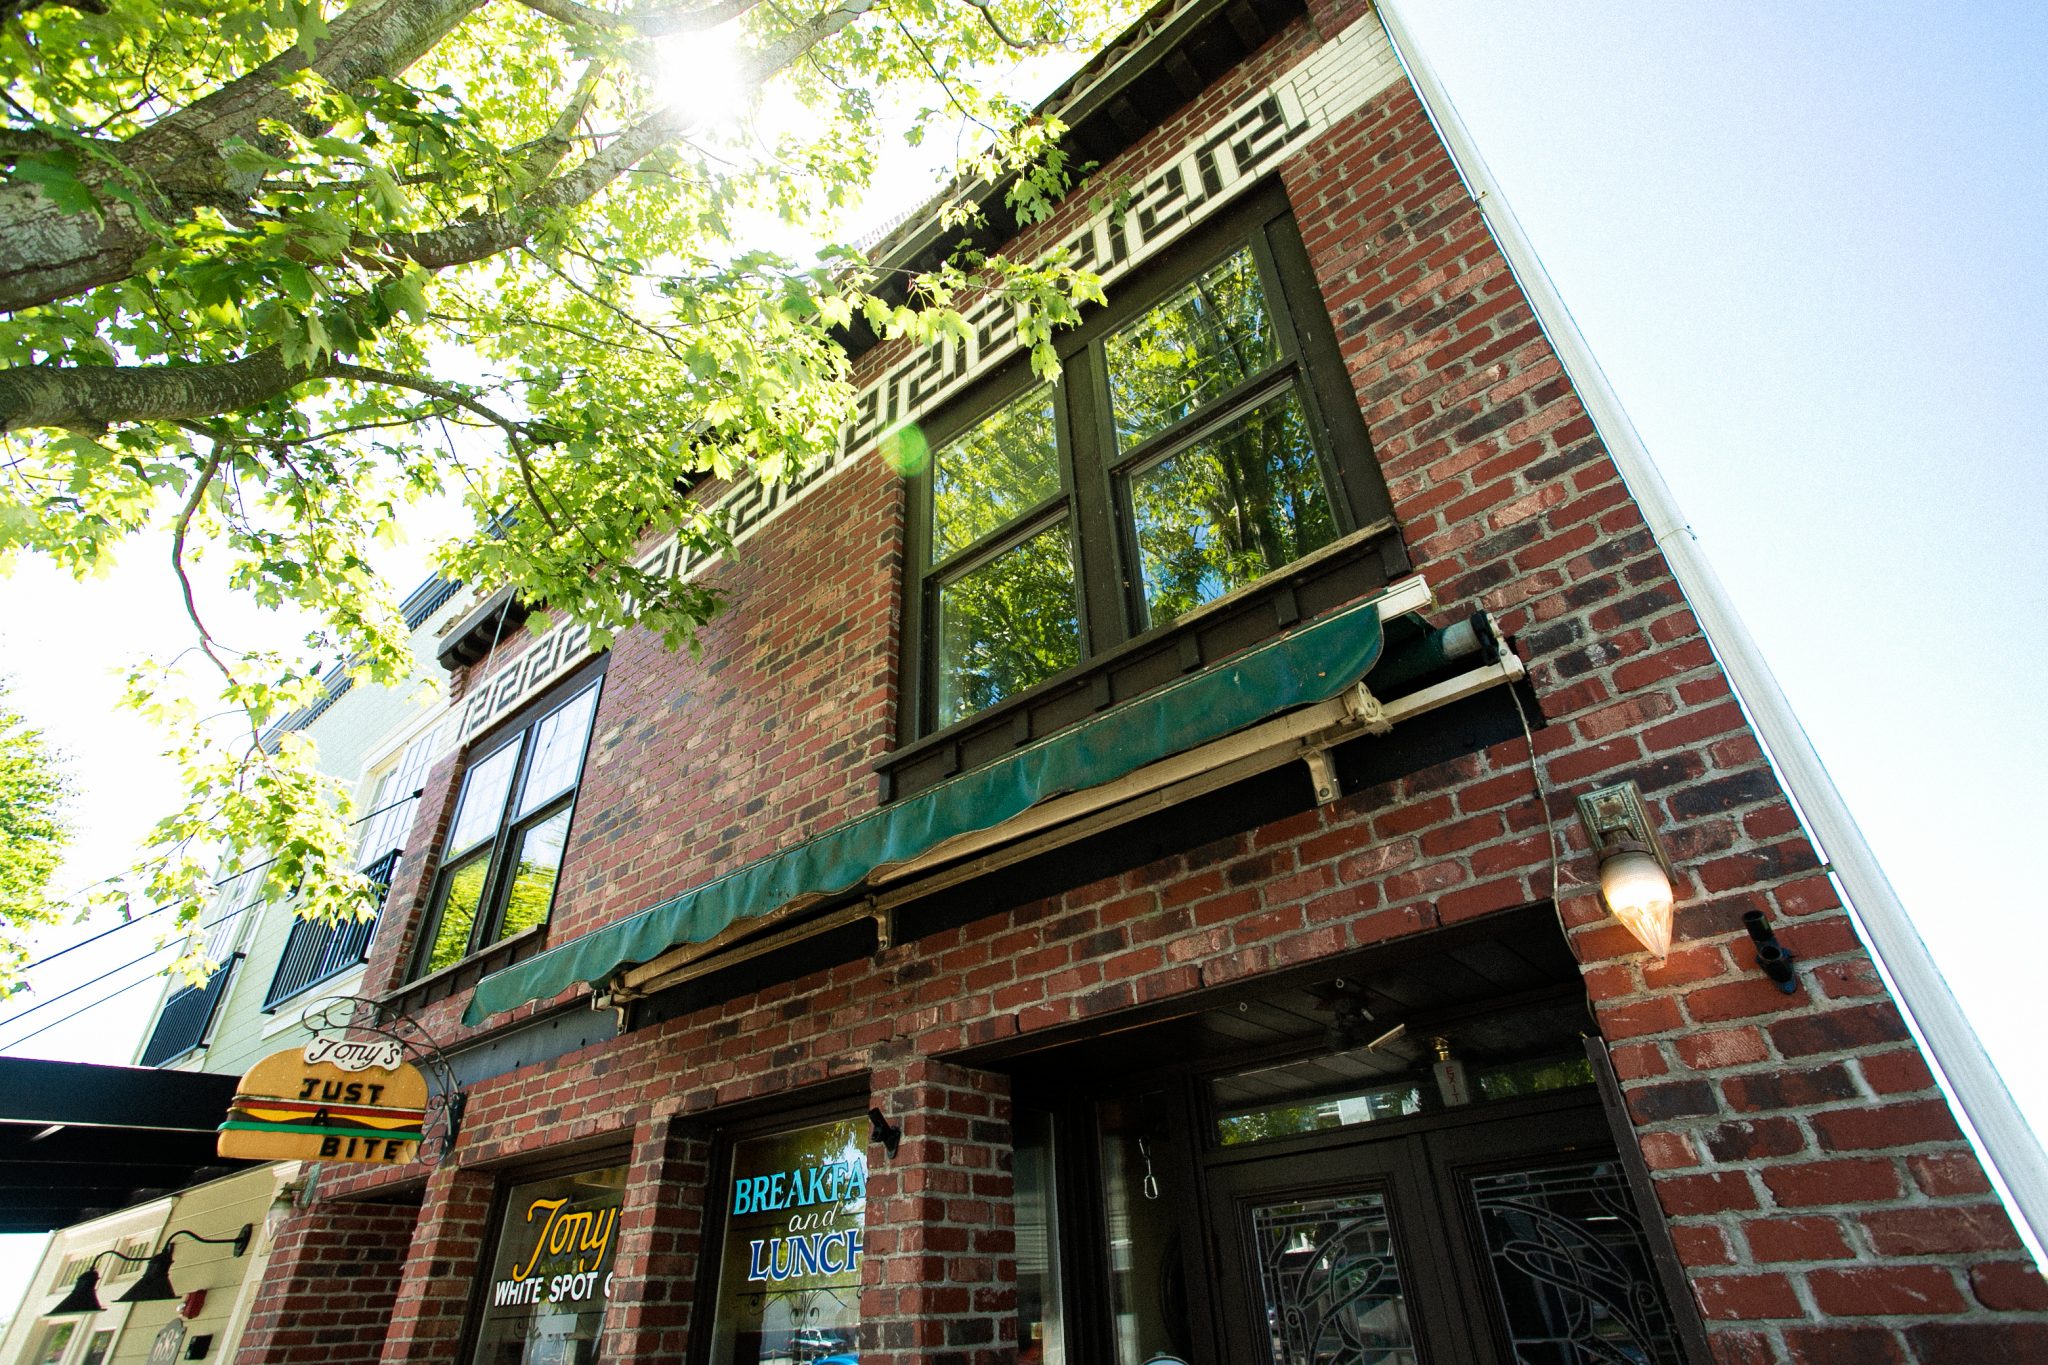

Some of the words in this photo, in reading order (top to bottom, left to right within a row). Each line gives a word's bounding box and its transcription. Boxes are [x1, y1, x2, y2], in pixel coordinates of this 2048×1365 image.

[308, 1038, 401, 1070] Tony's
[299, 1077, 385, 1104] JUST
[1445, 1066, 1460, 1103] EXIT
[312, 1108, 329, 1128] A
[319, 1136, 403, 1160] BITE
[733, 1157, 866, 1216] BREAKFA
[788, 1201, 839, 1233] and
[494, 1276, 544, 1307] WHITE
[548, 1271, 598, 1304] SPOT
[152, 1329, 178, 1361] 685
